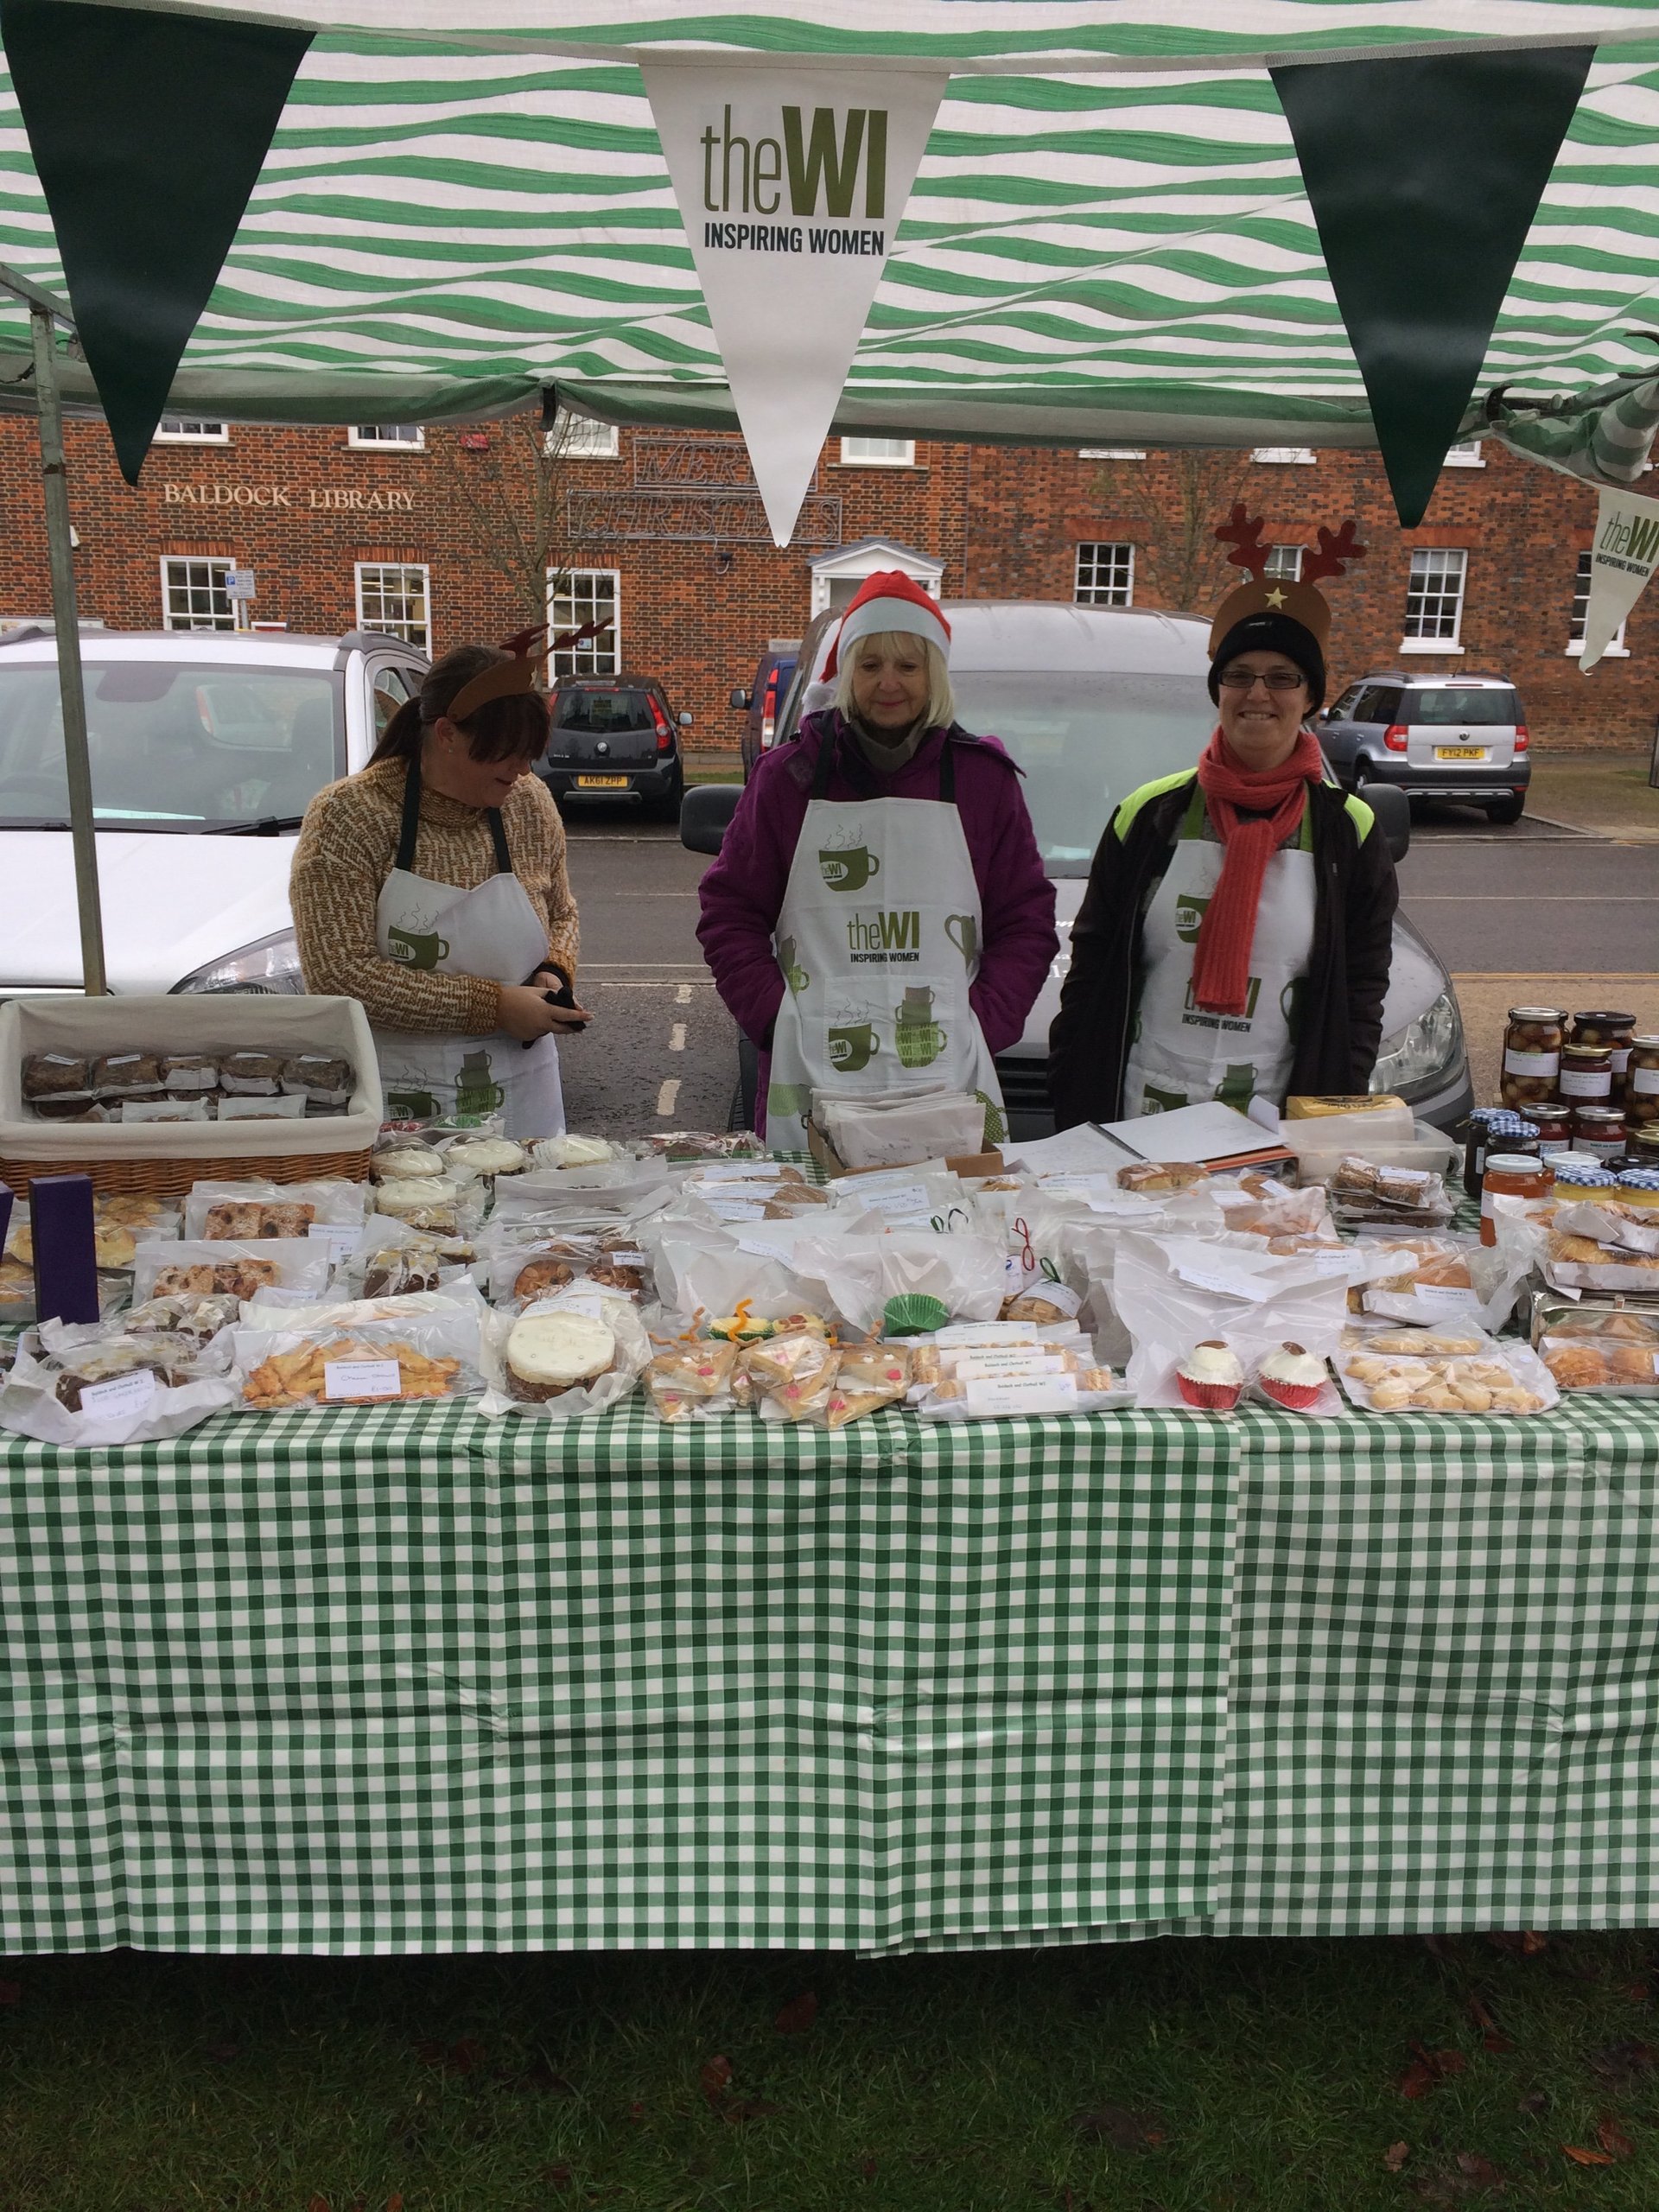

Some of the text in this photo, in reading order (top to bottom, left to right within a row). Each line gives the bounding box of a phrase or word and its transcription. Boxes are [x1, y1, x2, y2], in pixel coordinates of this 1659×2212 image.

[704, 222, 885, 256] INSPIRING WOMEN
[162, 483, 415, 511] BALDOCK LIBRARY
[576, 493, 838, 542] CHRISTMS
[1595, 552, 1650, 577] INSPIRING WOMEN
[850, 952, 920, 963] INSPIRING WOMEN
[1181, 1014, 1252, 1033] INSPIRING WOMEN
